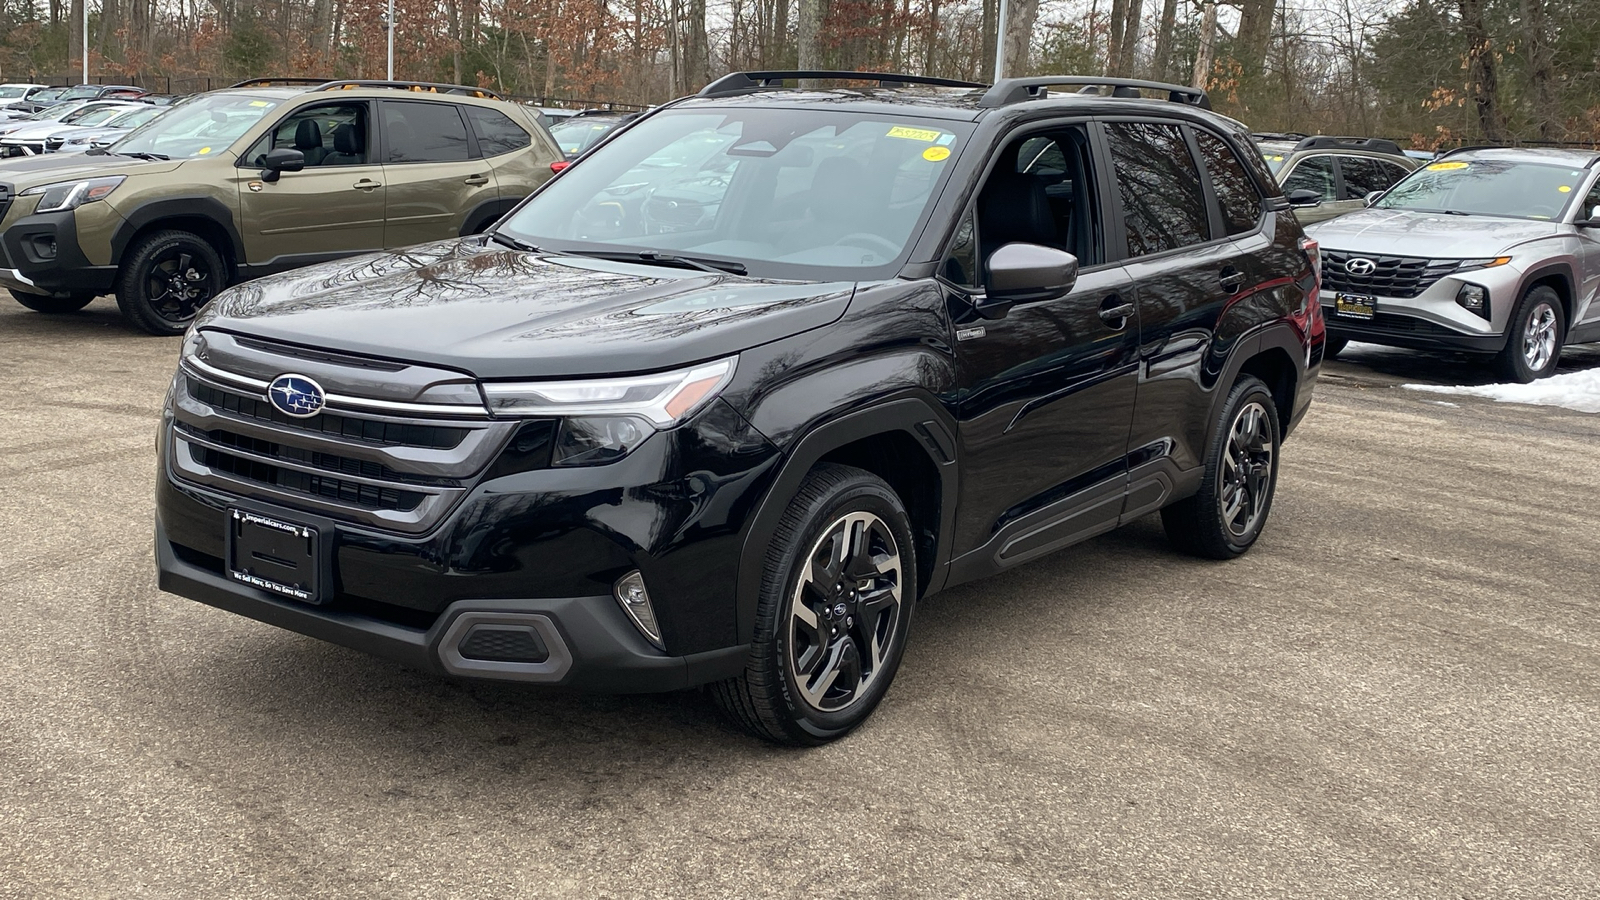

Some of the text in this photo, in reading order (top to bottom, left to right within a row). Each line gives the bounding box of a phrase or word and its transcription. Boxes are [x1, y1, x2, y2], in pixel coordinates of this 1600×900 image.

[234, 572, 242, 580] We
[242, 574, 251, 583] Sell
[265, 581, 272, 589] So
[272, 583, 282, 592] You
[281, 586, 293, 595] Save
[294, 589, 307, 598] More
